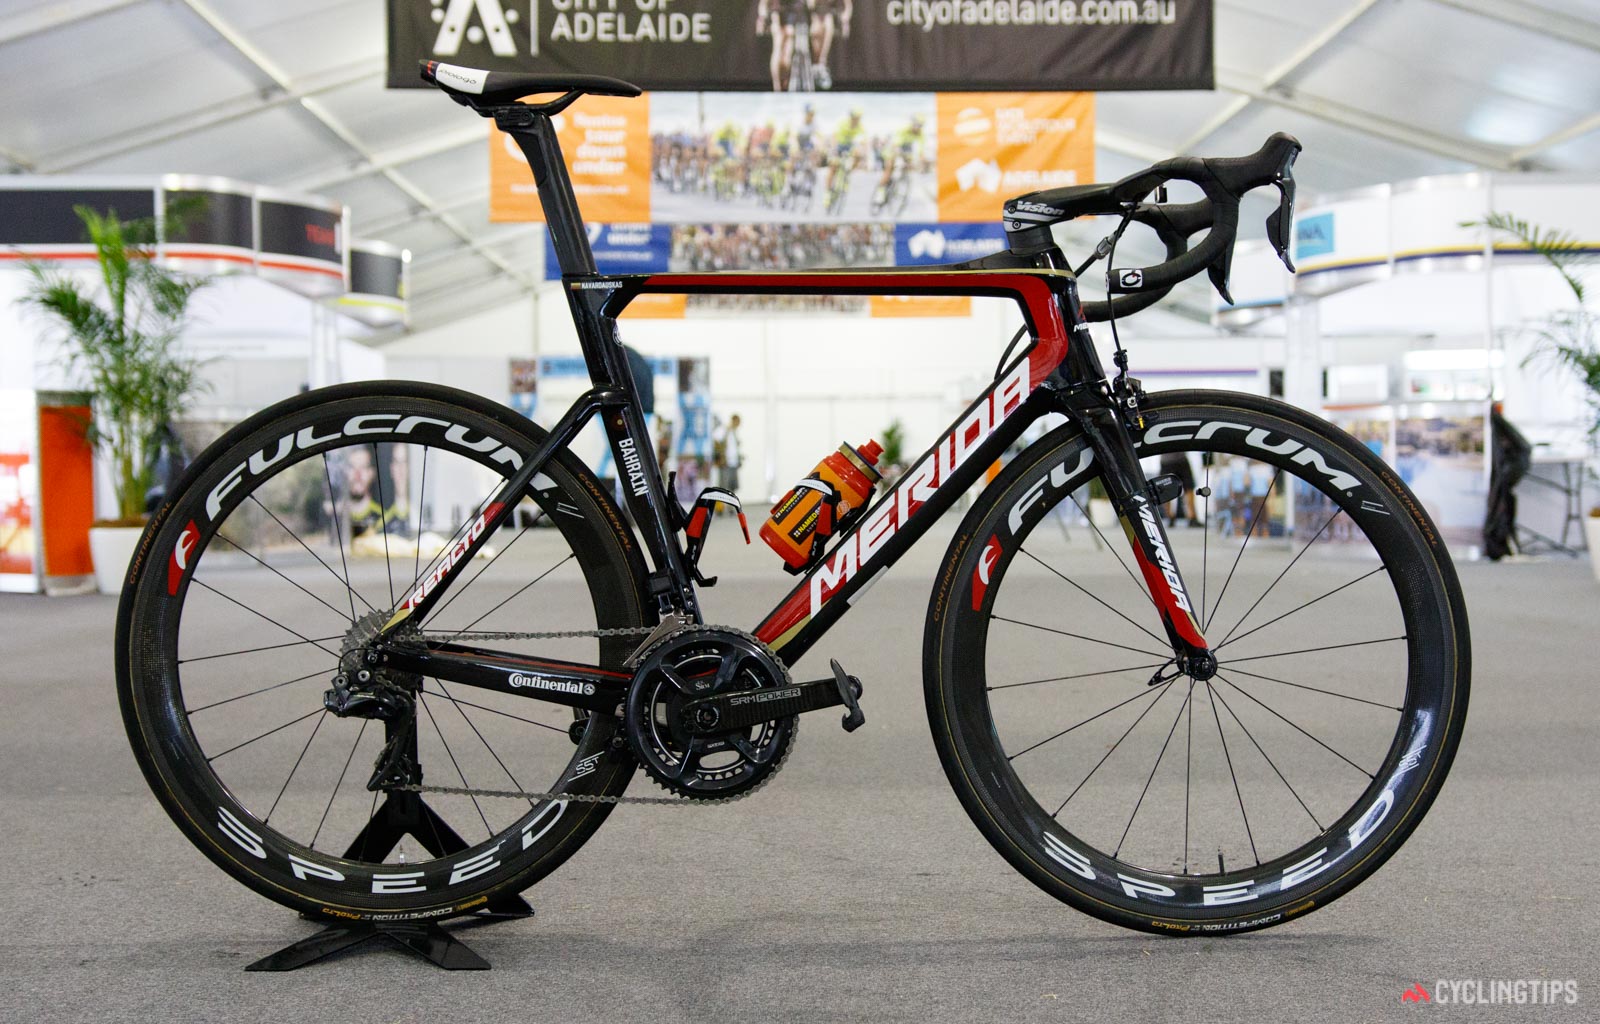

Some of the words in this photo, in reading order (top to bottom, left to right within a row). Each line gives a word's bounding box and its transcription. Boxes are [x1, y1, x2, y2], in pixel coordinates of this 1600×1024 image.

[551, 12, 712, 42] ADELAIDE
[1017, 200, 1065, 216] Vision
[618, 438, 649, 497] BAHRAIN
[811, 356, 1030, 620] MERIDA
[1008, 420, 1362, 536] FUCRUM
[129, 501, 172, 585] CONTINENTAL
[578, 472, 632, 552] CONTINENTAL
[409, 514, 485, 613] REACTO
[934, 532, 969, 622] CONTINENTAL
[1133, 495, 1191, 612] MERIDA
[508, 672, 583, 695] Continental
[757, 688, 801, 702] POWER
[217, 794, 569, 894] SPEED
[1043, 789, 1394, 906] SPEED
[372, 907, 453, 921] COMPETITION
[1202, 913, 1281, 931] COMPETITION
